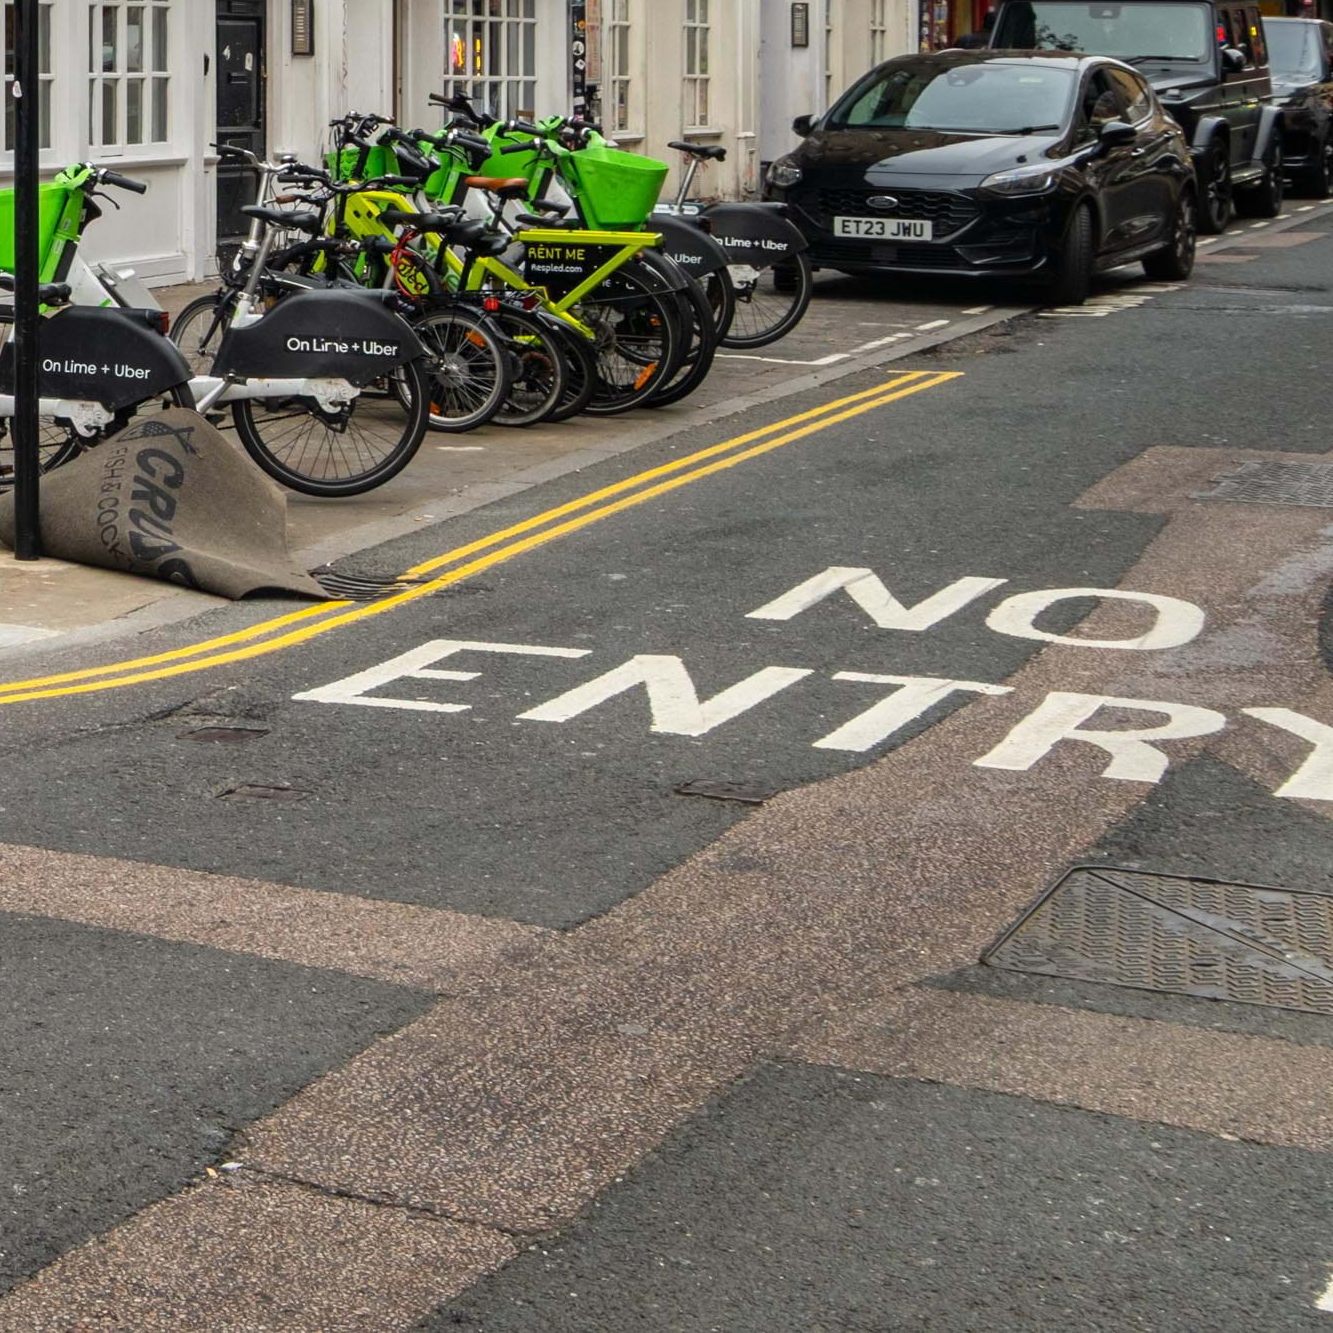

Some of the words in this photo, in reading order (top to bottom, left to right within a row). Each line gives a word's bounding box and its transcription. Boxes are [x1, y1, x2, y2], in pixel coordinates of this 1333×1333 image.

[841, 219, 885, 236] ET23
[890, 221, 924, 237] JWU
[528, 247, 562, 259] RENT
[566, 248, 586, 260] ME
[724, 237, 751, 247] Lime
[762, 239, 789, 251] Uber
[675, 253, 702, 265] Uber
[287, 337, 310, 351] On
[362, 341, 398, 356] Uber
[42, 359, 61, 372] On
[64, 359, 97, 374] Lime
[115, 364, 151, 379] Uber
[104, 446, 128, 479] FISH
[97, 497, 129, 563] COCK
[744, 565, 1206, 651] NO
